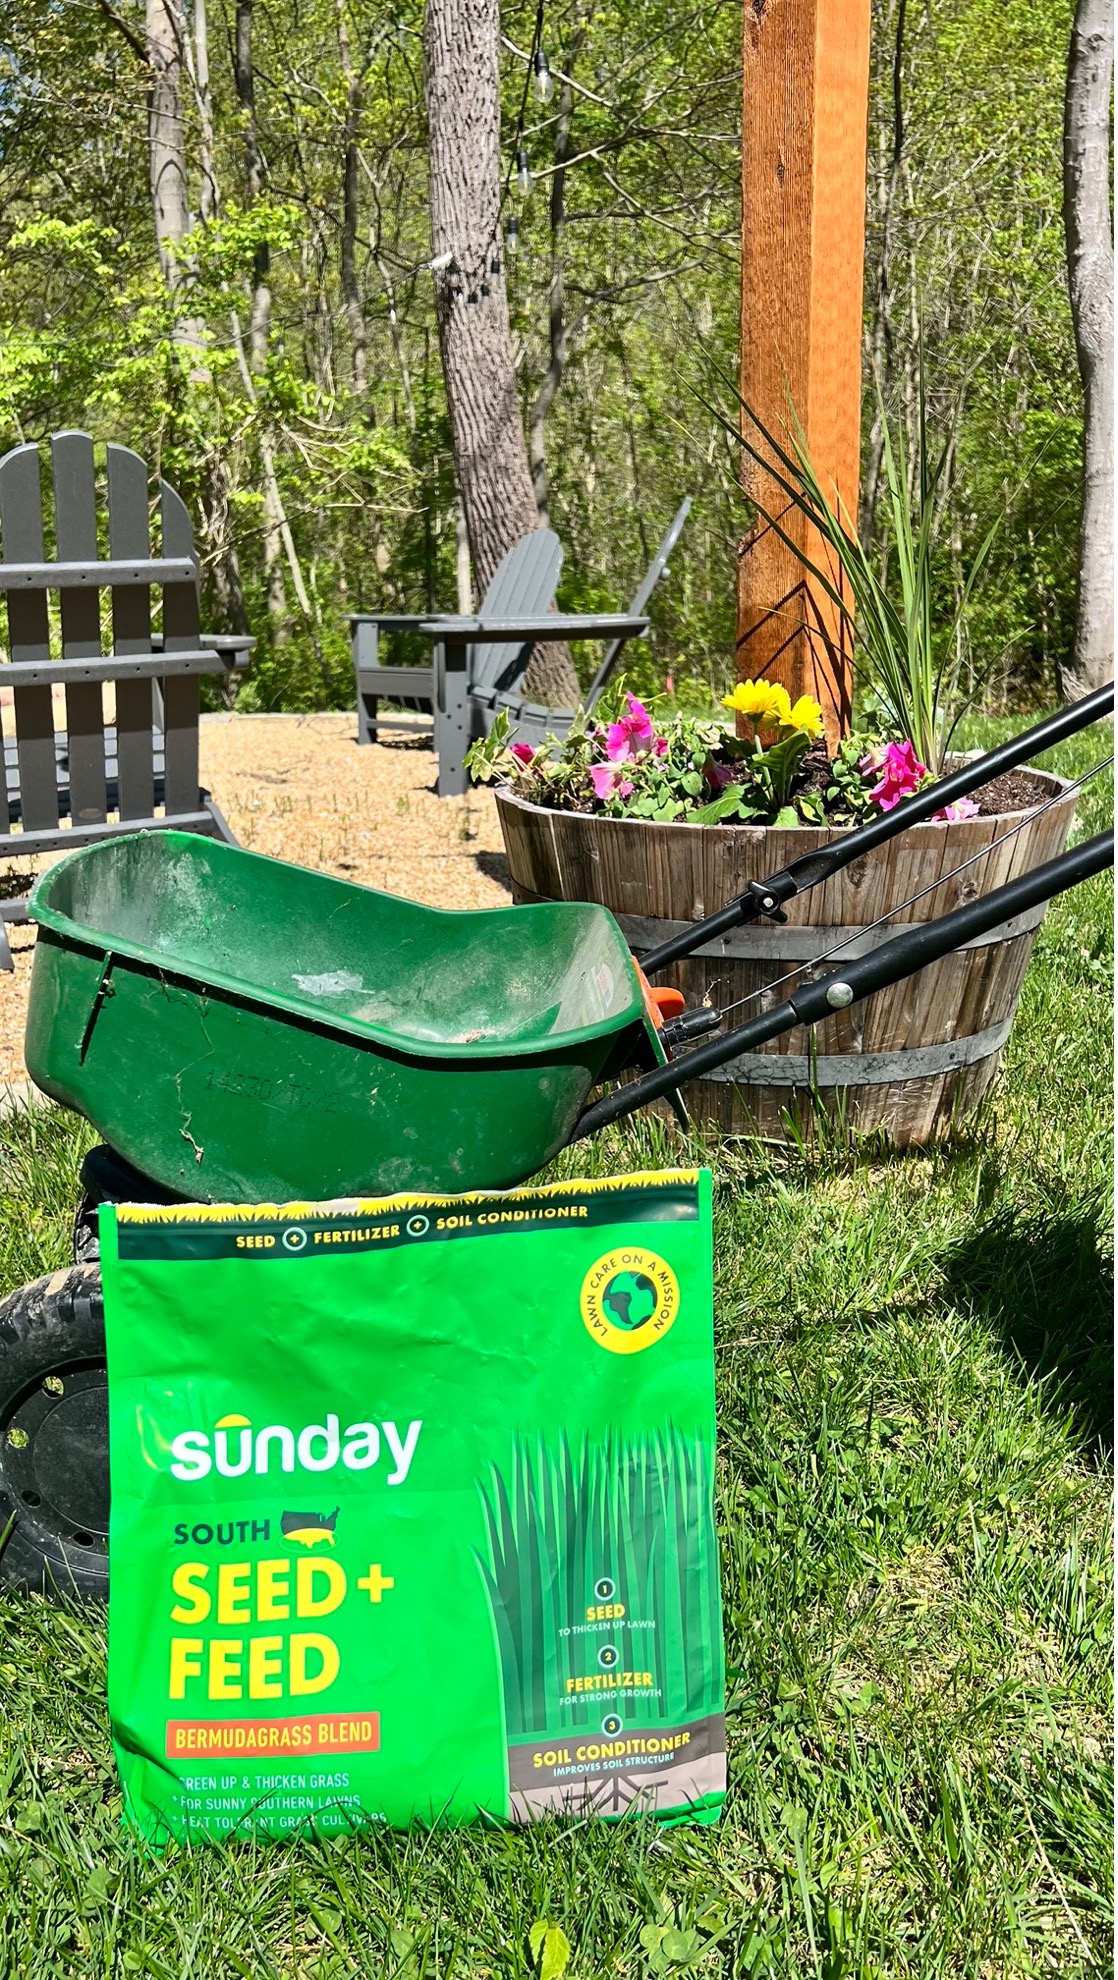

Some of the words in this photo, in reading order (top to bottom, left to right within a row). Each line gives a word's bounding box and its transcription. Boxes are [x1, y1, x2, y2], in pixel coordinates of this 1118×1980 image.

[236, 1235, 276, 1248] SEED
[314, 1224, 400, 1244] FERTILIZER
[436, 1215, 472, 1230] SOIL
[477, 1206, 588, 1225] CONDITIONER
[621, 1254, 643, 1264] ON
[647, 1261, 656, 1271] A
[590, 1258, 617, 1289] CARE
[653, 1271, 673, 1331] MISSION
[587, 1295, 608, 1336] LAWN
[170, 1414, 423, 1485] sunday
[173, 1519, 271, 1545] SOUTH
[170, 1557, 347, 1625] SEED
[586, 1604, 625, 1621] SEED
[559, 1628, 570, 1636] TO
[572, 1622, 610, 1634] THICKEN
[627, 1620, 655, 1629] LAWN
[169, 1632, 341, 1700] FEED
[566, 1672, 653, 1693] FERTILIZER
[559, 1697, 577, 1705] FOR
[580, 1690, 617, 1702] STRONG
[620, 1689, 662, 1698] GROWTH
[175, 1725, 312, 1748] BERMUDAGRASS
[318, 1721, 372, 1743] BLEND
[533, 1749, 572, 1768] SOIL
[576, 1732, 690, 1761] CONDITIONER
[553, 1762, 600, 1776] IMPROVES
[603, 1759, 623, 1769] SOIL
[625, 1752, 674, 1766] STRUCTURE
[221, 1776, 237, 1789] UP
[242, 1776, 251, 1788] &
[255, 1774, 306, 1788] THICKEN
[310, 1773, 349, 1788] GRASS
[180, 1795, 202, 1809] FOR
[206, 1797, 246, 1810] SUNNY
